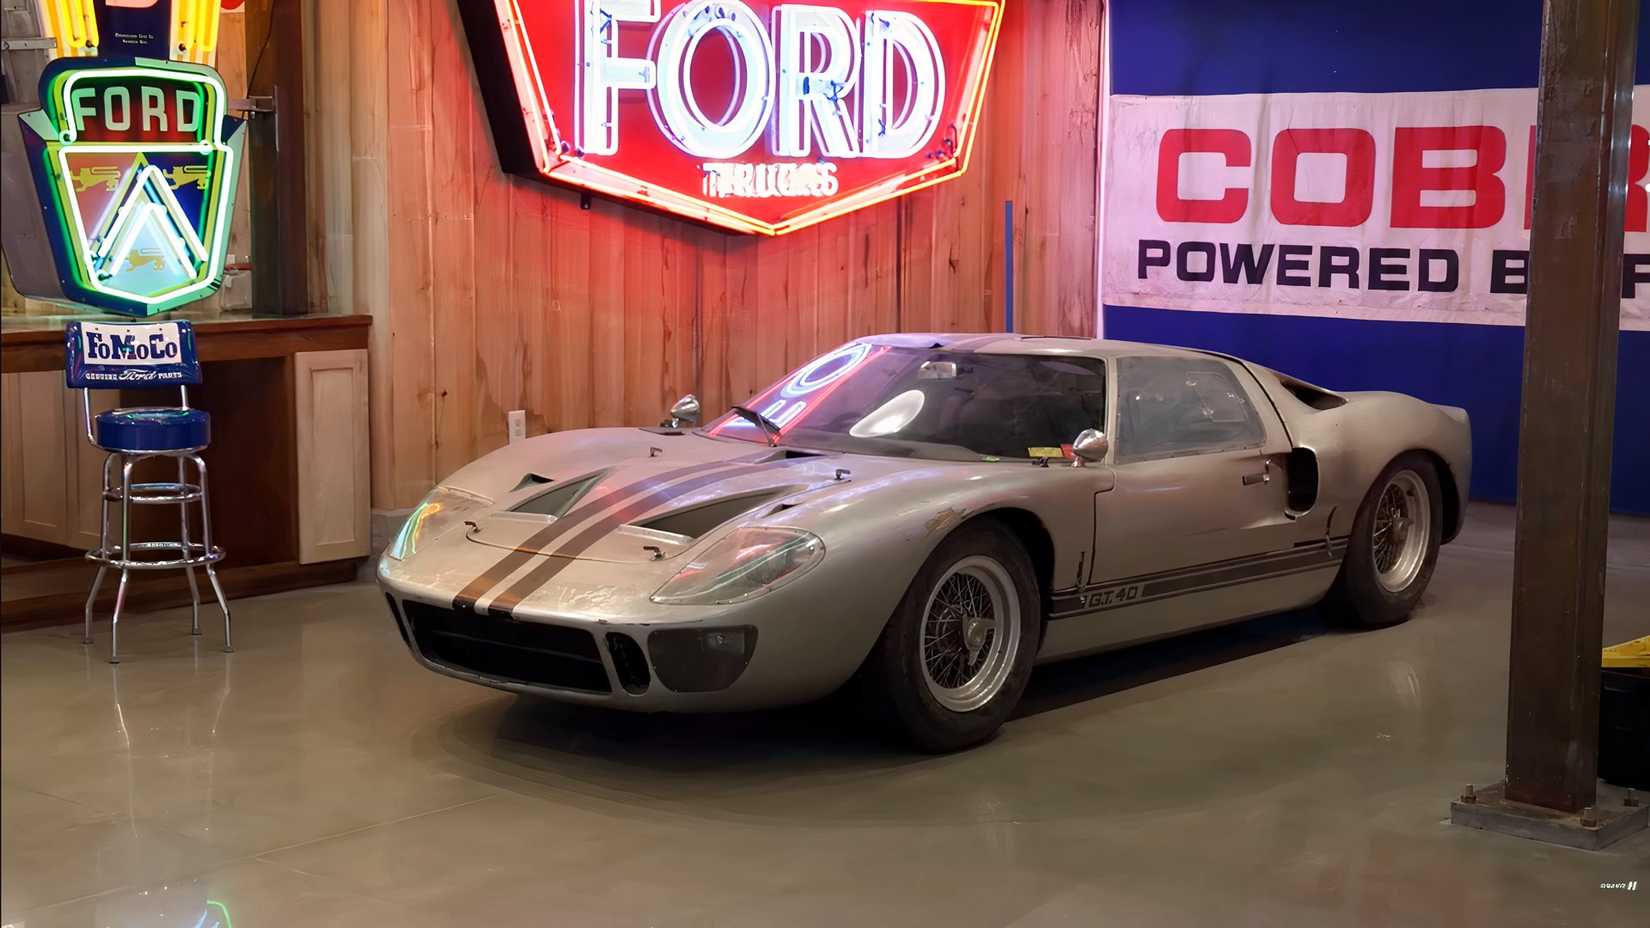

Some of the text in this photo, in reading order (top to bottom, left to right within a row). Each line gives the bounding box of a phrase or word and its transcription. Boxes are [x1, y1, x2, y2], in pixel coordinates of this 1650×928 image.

[575, 0, 946, 158] FORD
[71, 86, 203, 132] FORD
[1138, 239, 1460, 293] POWERED
[86, 332, 178, 360] FoMoCo
[118, 368, 158, 381] Ford
[158, 371, 183, 380] PARTS
[1115, 585, 1138, 602] 40
